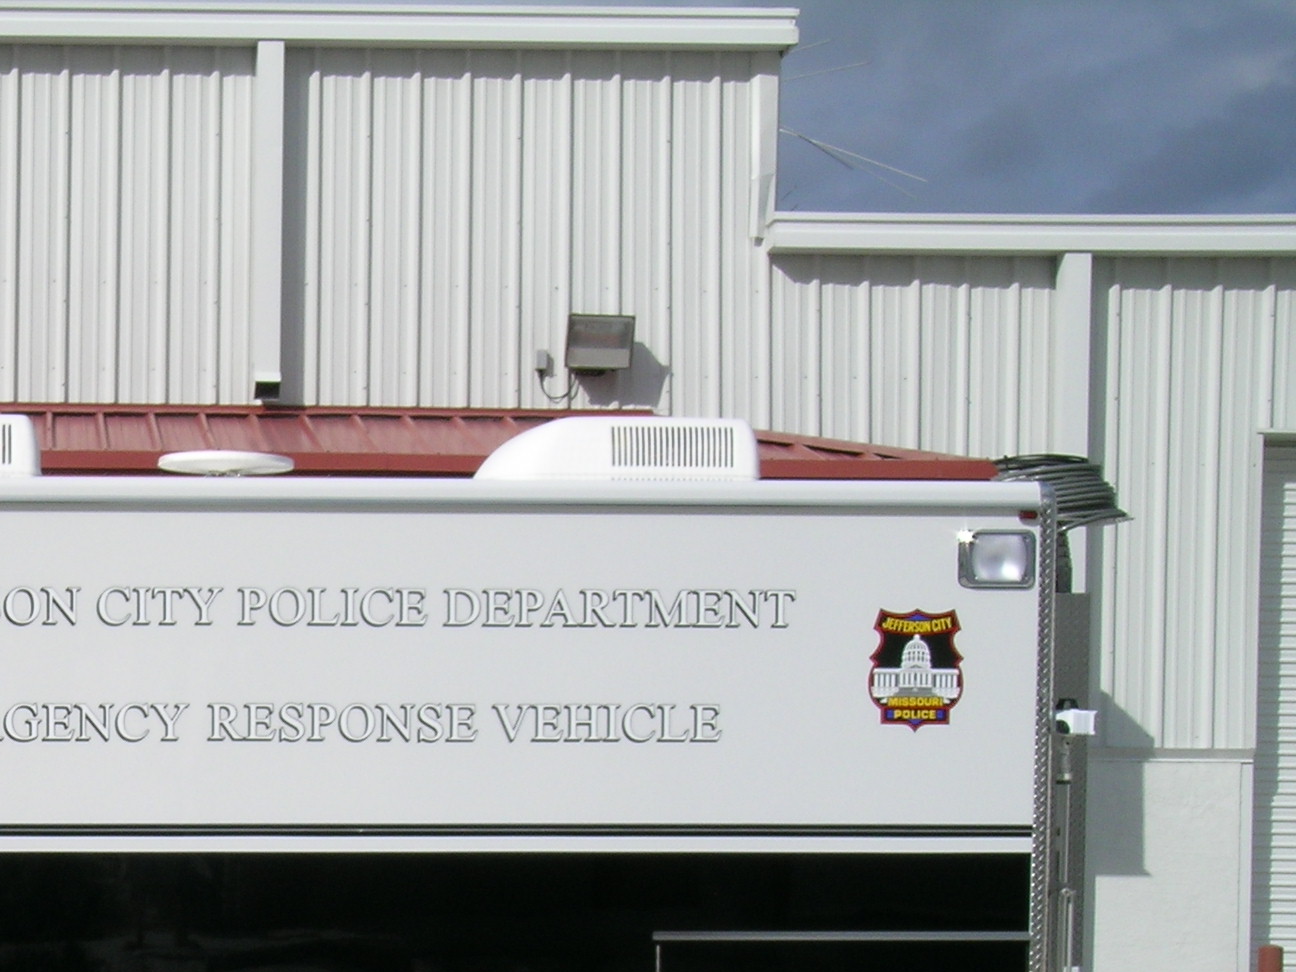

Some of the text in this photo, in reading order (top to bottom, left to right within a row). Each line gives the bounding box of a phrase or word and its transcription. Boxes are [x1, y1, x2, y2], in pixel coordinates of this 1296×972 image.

[95, 586, 225, 628] CITY
[237, 586, 429, 629] POLICE
[442, 587, 798, 630] DEPARTMENT
[882, 617, 952, 633] JEFFERSON CITY
[887, 696, 944, 707] MISSOURI
[893, 709, 937, 720] POLICE
[206, 702, 479, 744] RESPONSE
[491, 702, 724, 744] VEHICLE
